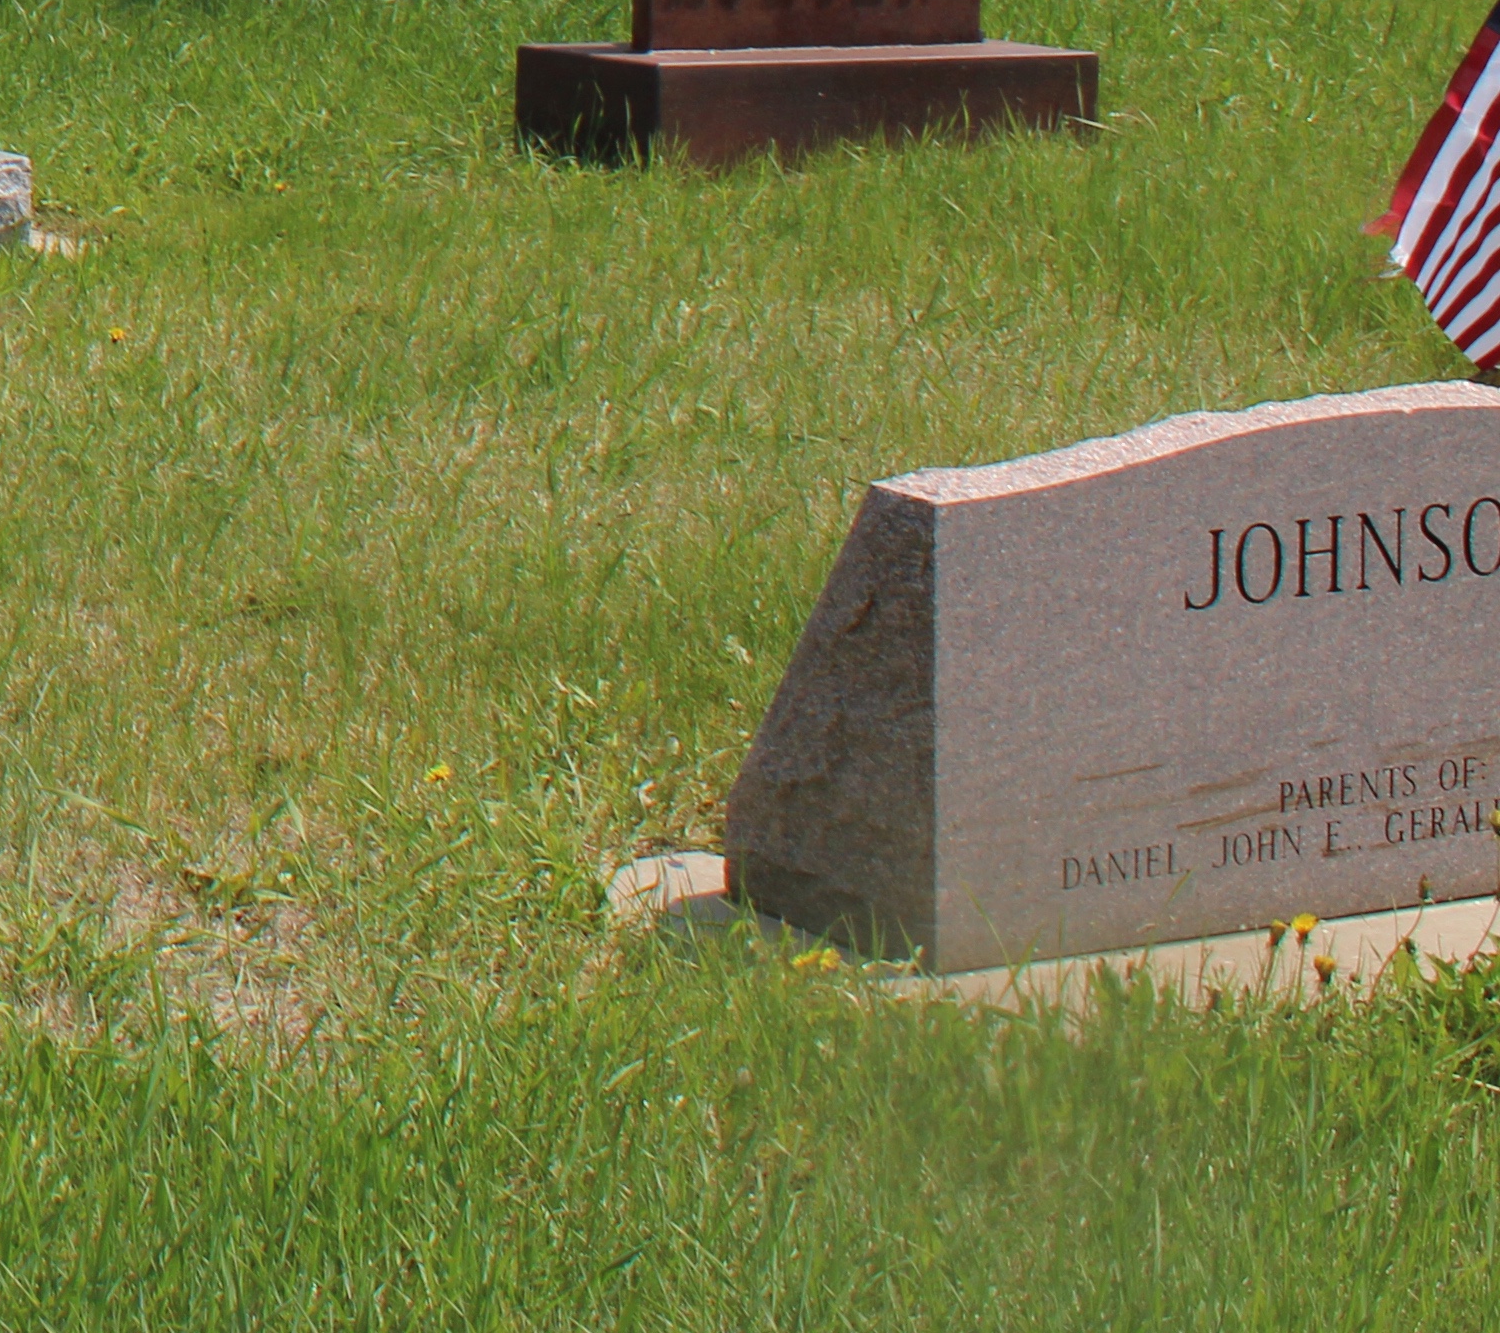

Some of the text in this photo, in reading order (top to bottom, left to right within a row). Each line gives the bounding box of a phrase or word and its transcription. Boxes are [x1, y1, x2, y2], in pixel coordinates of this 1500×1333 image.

[1277, 755, 1487, 814] PARENTS OF:
[1060, 842, 1192, 891] DANIEL,
[1211, 826, 1304, 869] JOHN
